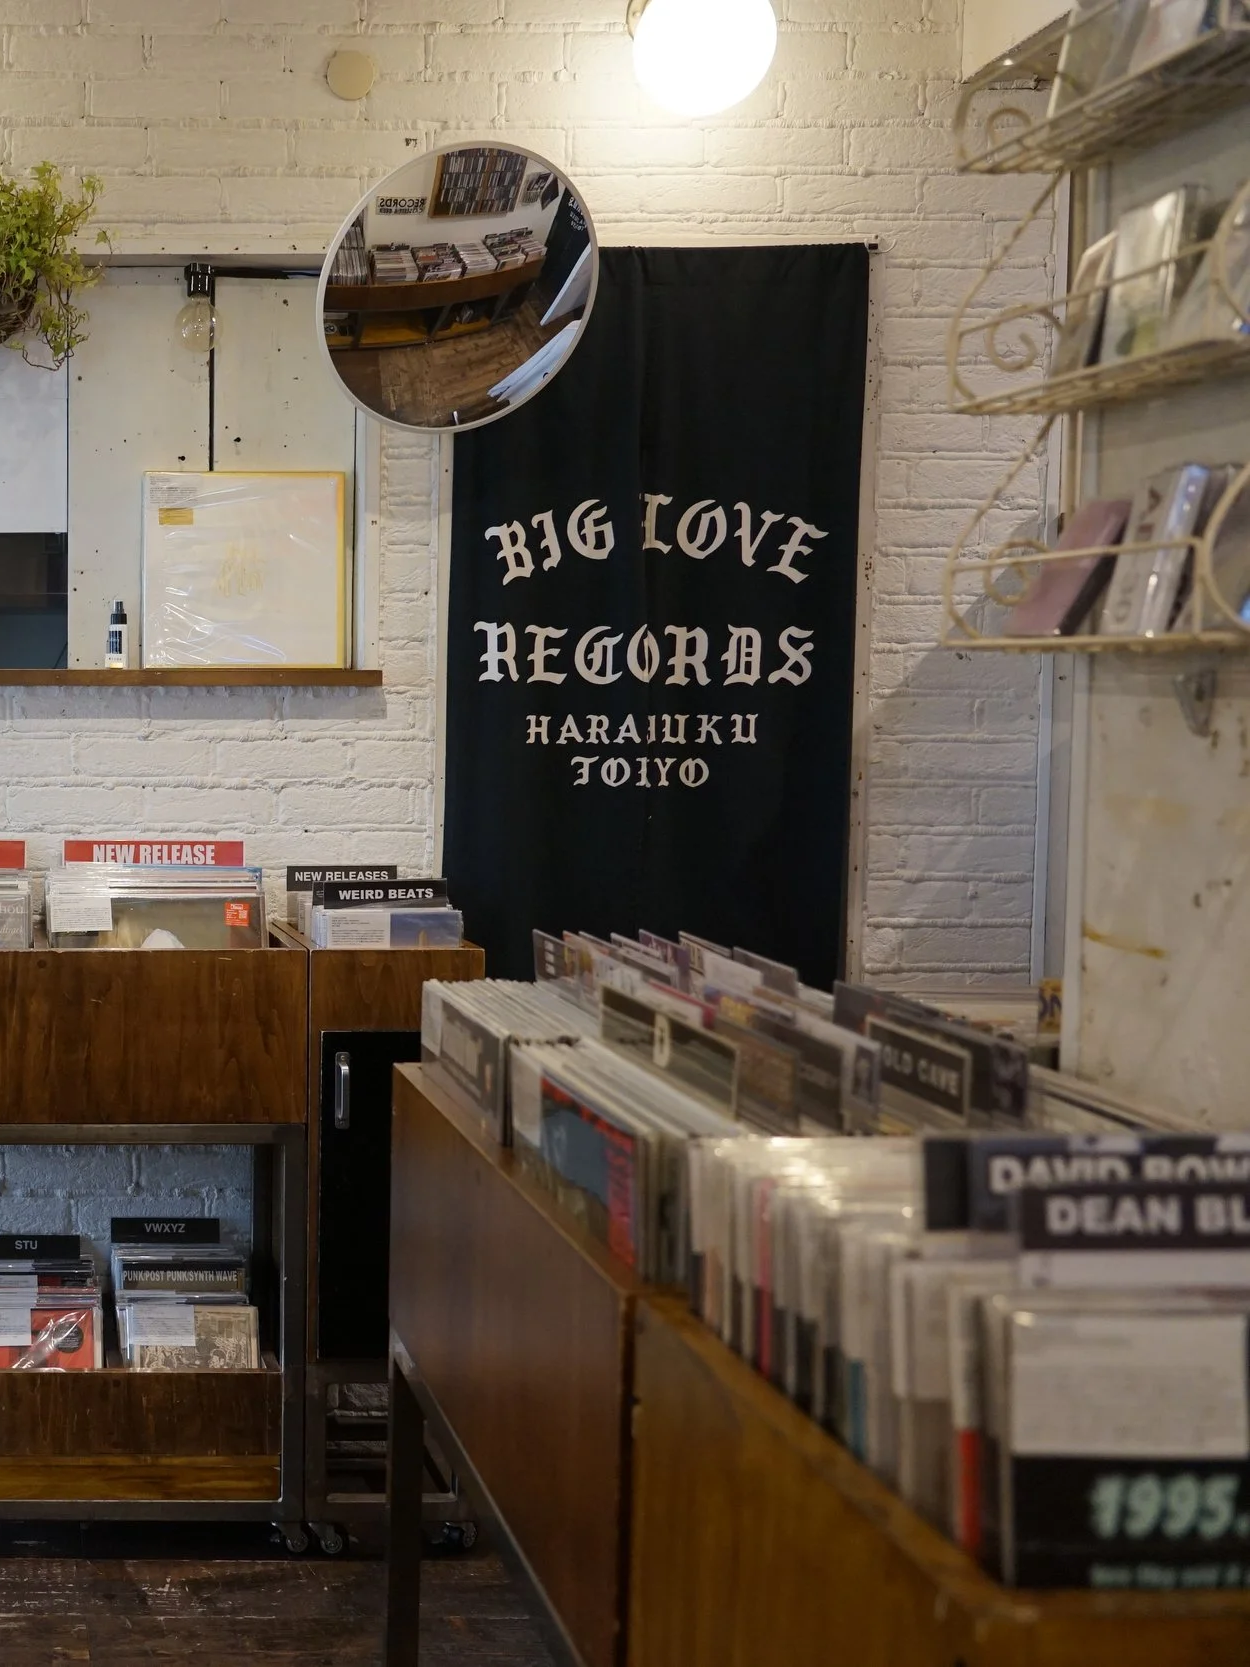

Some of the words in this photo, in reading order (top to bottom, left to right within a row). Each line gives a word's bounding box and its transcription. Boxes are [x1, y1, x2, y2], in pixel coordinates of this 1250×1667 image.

[484, 499, 615, 586] BIG
[640, 492, 830, 584] LOVE
[473, 622, 815, 686] RECORDS
[92, 844, 137, 864] NEW
[139, 844, 215, 865] RELEASE
[295, 871, 323, 882] NEW
[325, 871, 389, 881] RELEASES
[338, 889, 384, 900] WEIRD
[388, 888, 434, 899] BEATS
[988, 1155, 1131, 1195] DAVID
[1046, 1195, 1182, 1235] DEAN
[144, 1223, 186, 1233] VWXYZ
[14, 1240, 38, 1250] STU
[216, 1270, 238, 1282] WAVE
